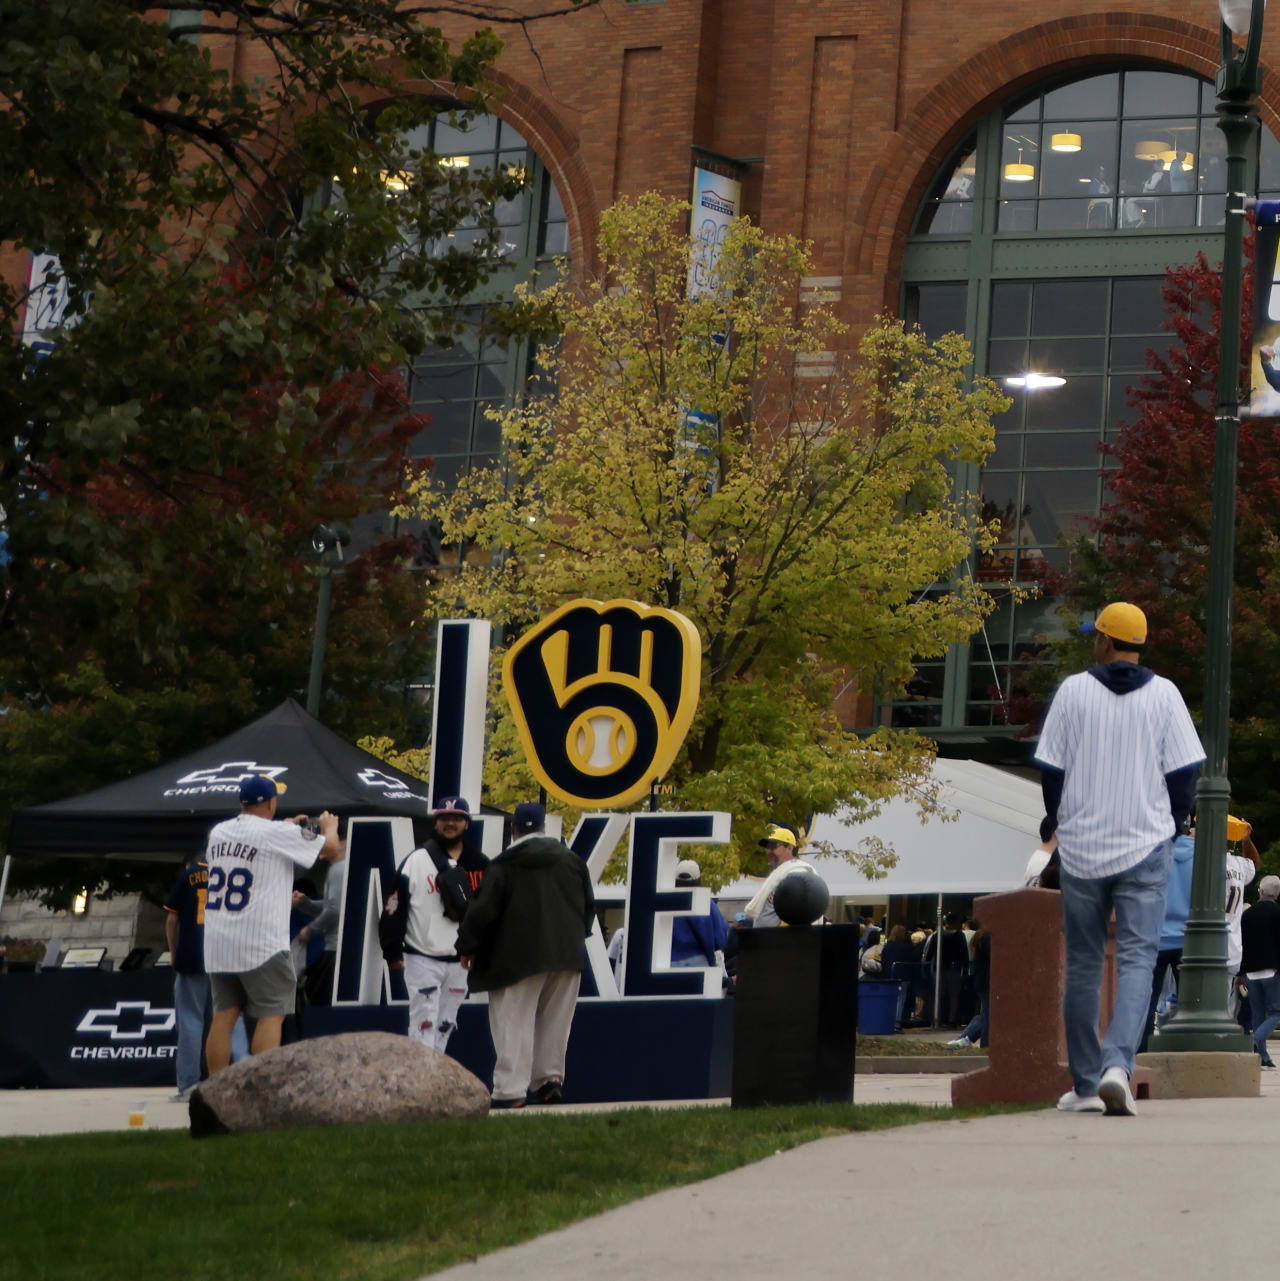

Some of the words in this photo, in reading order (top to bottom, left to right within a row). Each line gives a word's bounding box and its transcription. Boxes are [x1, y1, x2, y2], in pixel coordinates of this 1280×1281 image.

[163, 784, 242, 796] CHEVRO
[211, 841, 258, 862] FIELDER
[204, 866, 254, 912] 28
[70, 1046, 178, 1059] CHEVROLET
